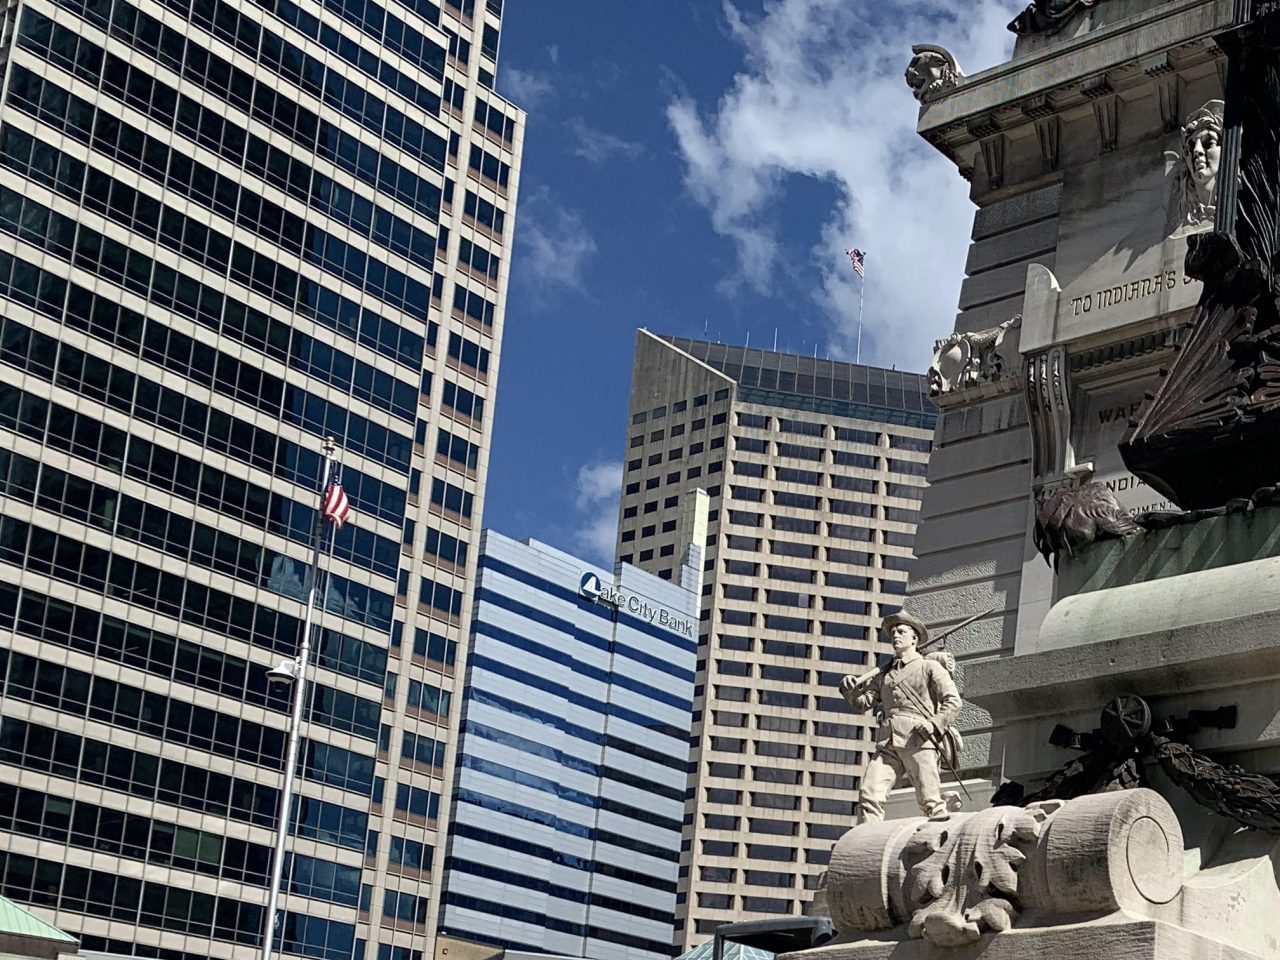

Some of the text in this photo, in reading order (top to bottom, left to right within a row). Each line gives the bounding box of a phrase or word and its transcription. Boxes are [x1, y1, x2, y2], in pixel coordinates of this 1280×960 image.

[1071, 270, 1176, 316] TO INDIANA'S
[1105, 475, 1146, 493] NDIA
[628, 595, 657, 622] City
[659, 608, 693, 637] Bank
